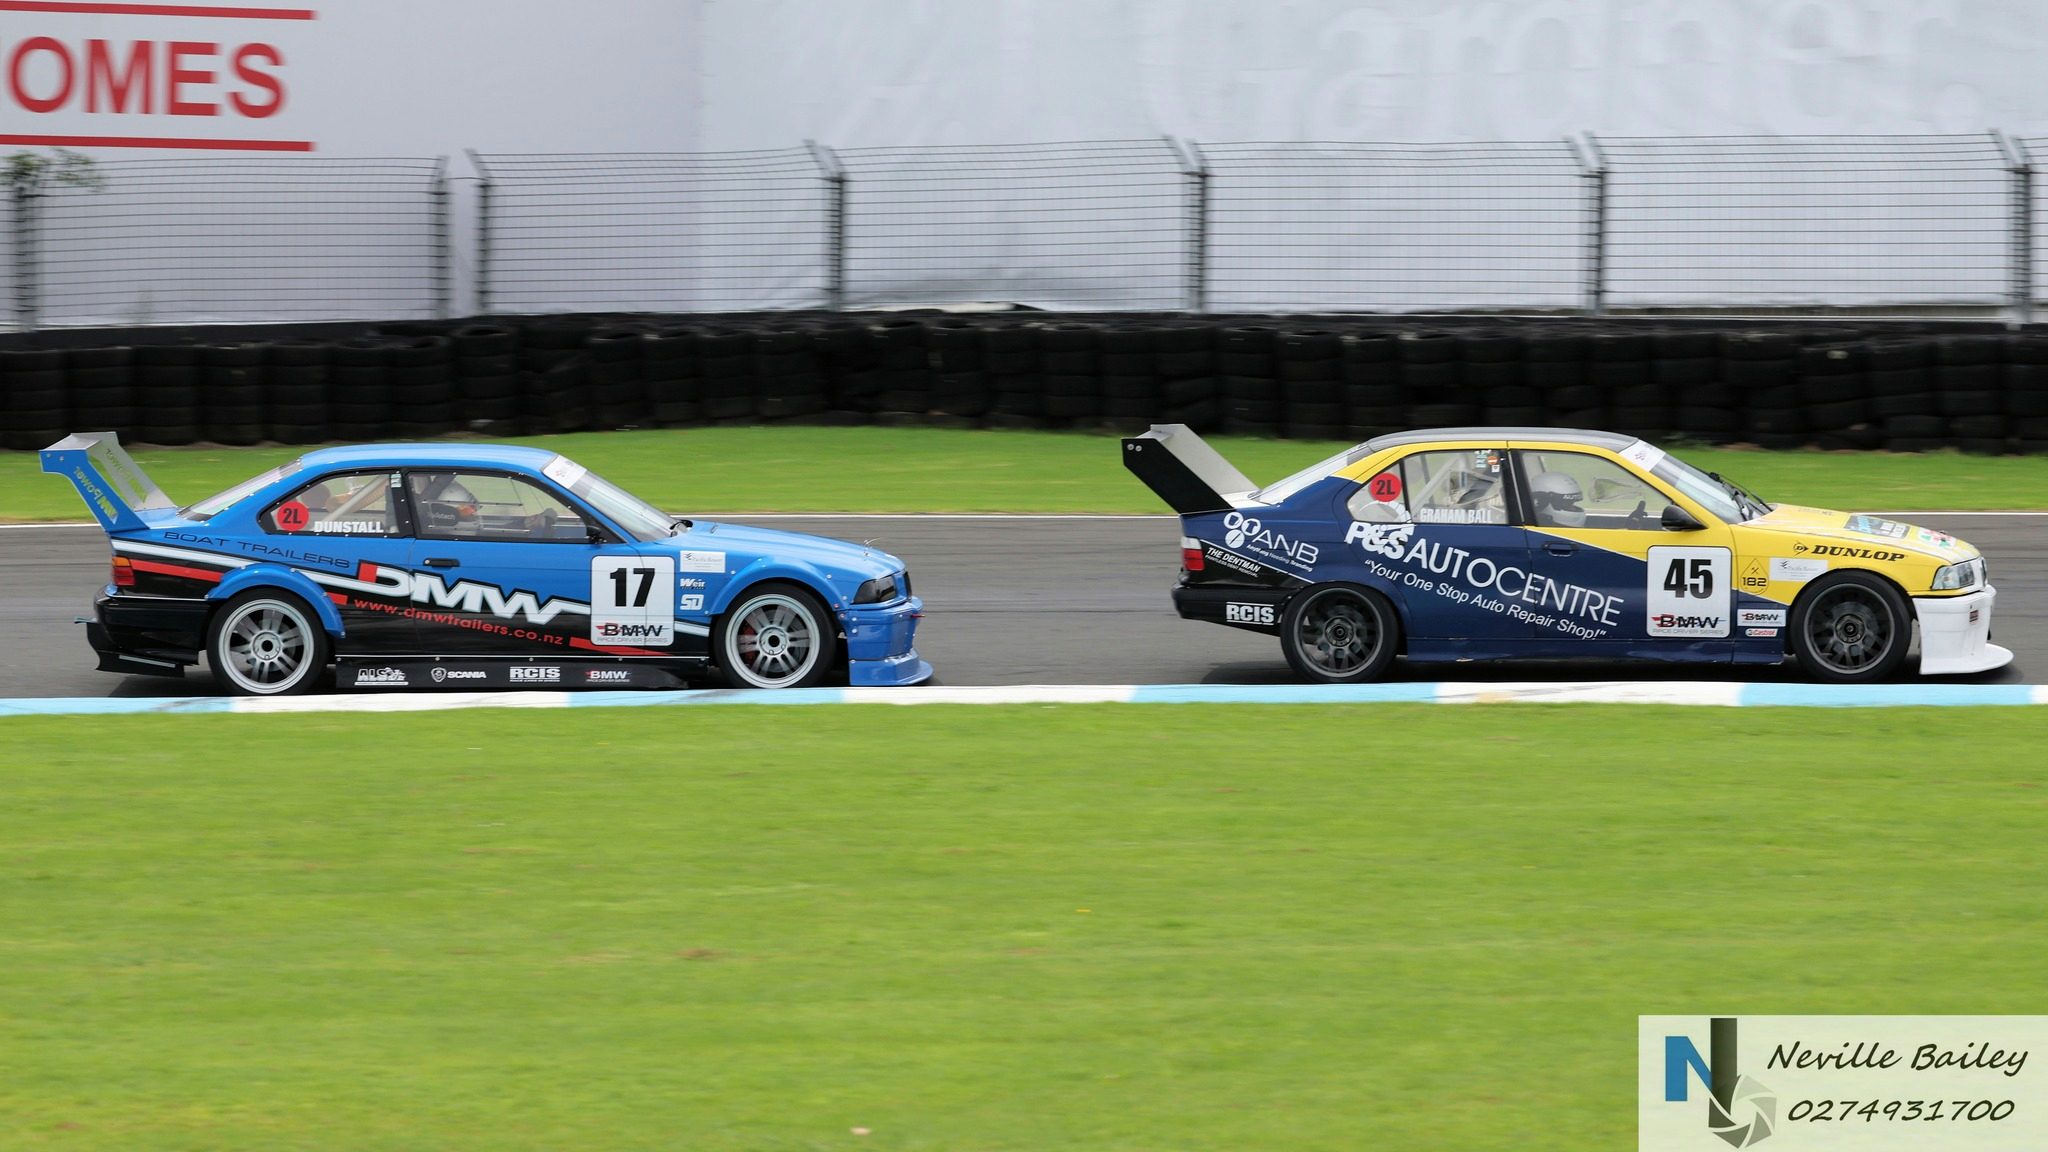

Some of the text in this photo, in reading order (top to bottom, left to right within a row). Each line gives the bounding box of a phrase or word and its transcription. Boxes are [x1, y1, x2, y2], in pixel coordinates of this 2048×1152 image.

[5, 36, 287, 118] OMES
[1376, 480, 1396, 495] 2L
[282, 507, 303, 524] 2L
[1420, 508, 1493, 524] GRAHAM BALL
[313, 520, 384, 533] DUNSTALL
[164, 531, 351, 568] BOAT TRAILERS
[1252, 529, 1320, 564] ANB
[1811, 544, 1905, 562] DUNLOP
[1207, 547, 1261, 573] THE DENTMAN
[1344, 521, 1625, 627] P&S AUTOCENTRE
[1664, 558, 1713, 599] 45
[1742, 577, 1767, 587] 182
[358, 560, 592, 626] DMW
[610, 567, 655, 607] 17
[1404, 572, 1434, 591] One
[1437, 582, 1469, 604] Stop
[1470, 593, 1505, 613] Auto
[1507, 604, 1556, 628] Repair
[354, 599, 564, 646] www.dmwtrailers.co.nz
[1226, 604, 1275, 623] RCIS
[1660, 614, 1720, 629] BMW
[603, 623, 664, 637] BMW
[447, 671, 487, 679] SCANIA
[510, 668, 560, 678] RCIS
[591, 670, 627, 679] BMW
